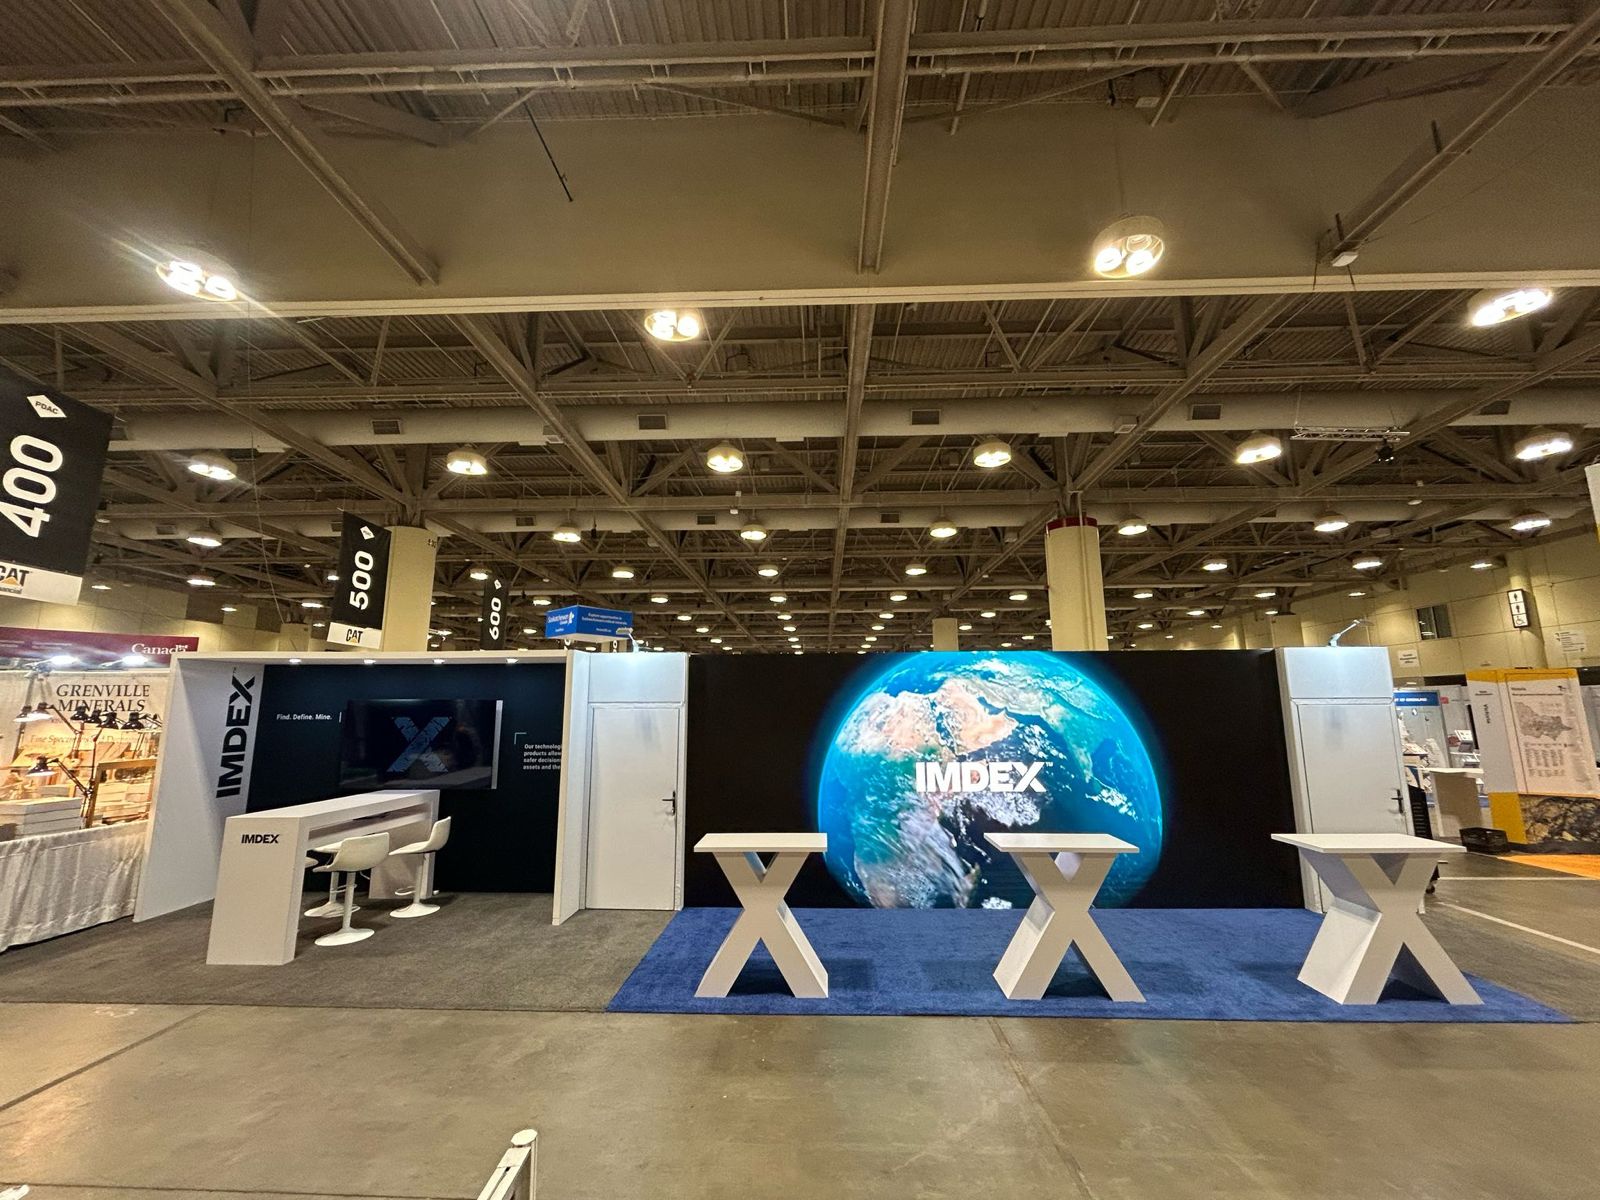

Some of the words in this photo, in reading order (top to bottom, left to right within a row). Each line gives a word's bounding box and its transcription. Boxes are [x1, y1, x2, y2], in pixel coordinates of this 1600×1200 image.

[35, 400, 59, 415] PDAC
[0, 434, 63, 538] 400
[349, 550, 374, 611] 500
[489, 597, 502, 641] 600
[345, 628, 364, 644] CAT
[56, 684, 150, 697] GRENVILLE
[57, 699, 146, 712] MINERALS
[216, 675, 256, 799] IMDEX
[915, 761, 1047, 793] IMDEX
[241, 834, 280, 844] IMDEX
